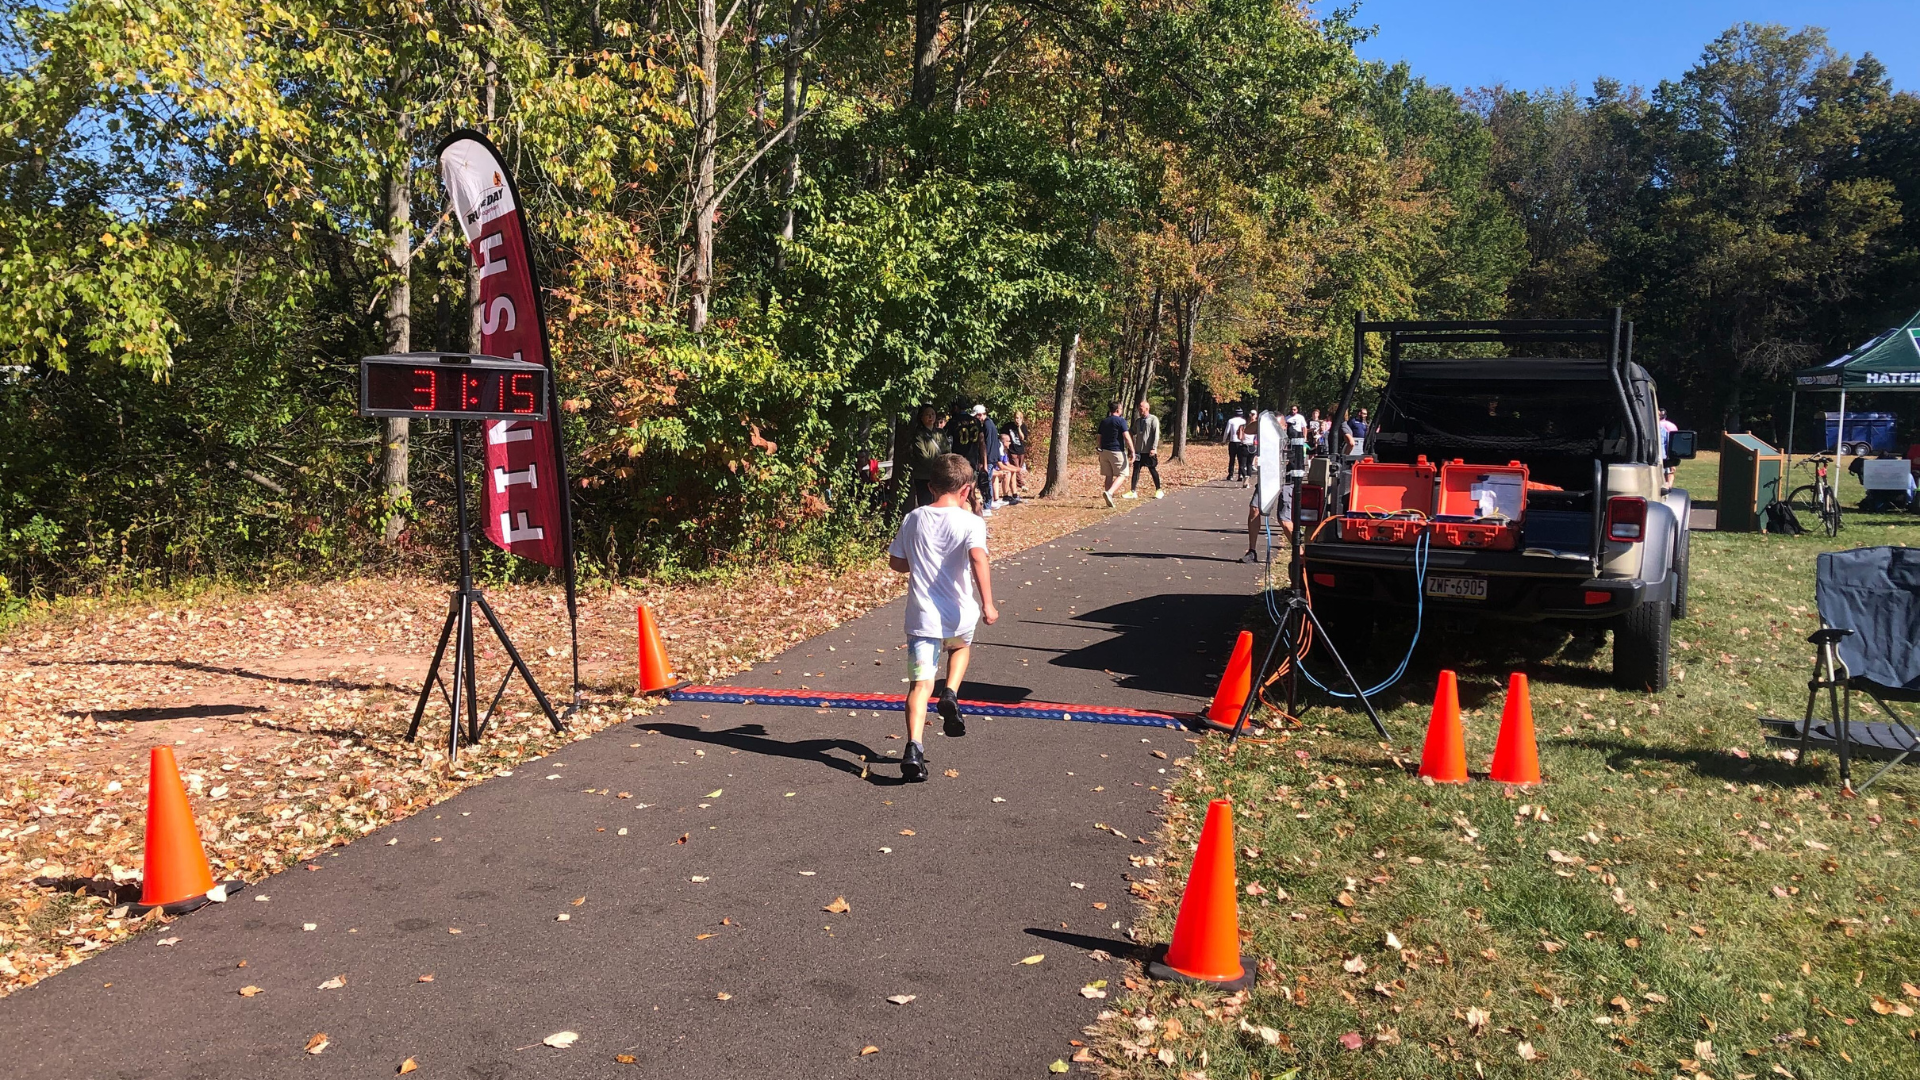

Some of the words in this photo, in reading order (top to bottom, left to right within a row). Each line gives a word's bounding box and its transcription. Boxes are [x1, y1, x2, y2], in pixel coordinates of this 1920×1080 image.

[487, 188, 503, 206] DAY
[413, 370, 534, 413] 31:15
[480, 231, 543, 544] FINSH
